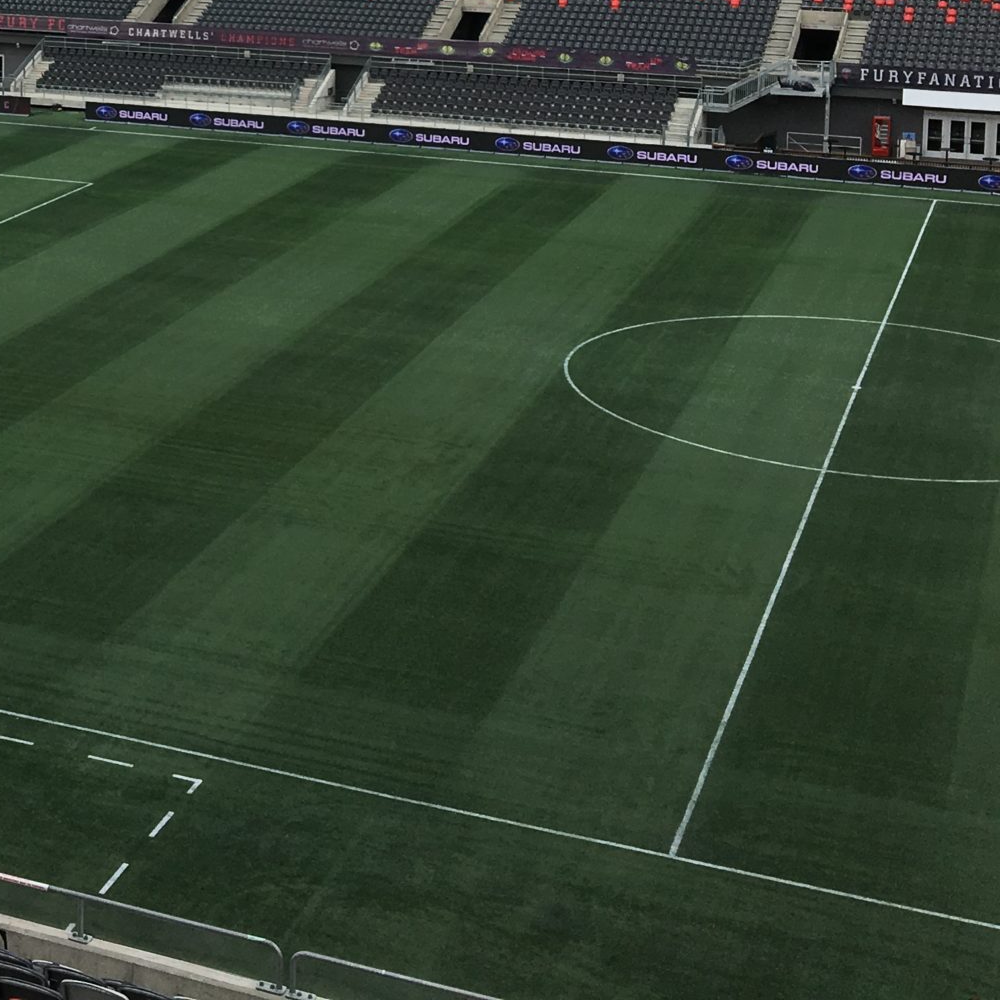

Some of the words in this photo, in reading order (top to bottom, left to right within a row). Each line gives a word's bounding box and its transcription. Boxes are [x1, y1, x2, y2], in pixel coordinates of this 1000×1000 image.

[47, 19, 66, 31] FC
[128, 27, 214, 41] CHARTWELLS'
[860, 68, 1000, 89] FURYFANATI
[119, 109, 168, 122] SUBARU
[213, 117, 264, 130] SUBARU
[312, 125, 365, 138] SUBARU
[415, 132, 470, 146] SUBARU
[523, 141, 581, 154] SUBARU
[636, 150, 698, 164] SUBARU
[756, 159, 819, 174] SUBARU
[880, 169, 947, 184] SUBARU
